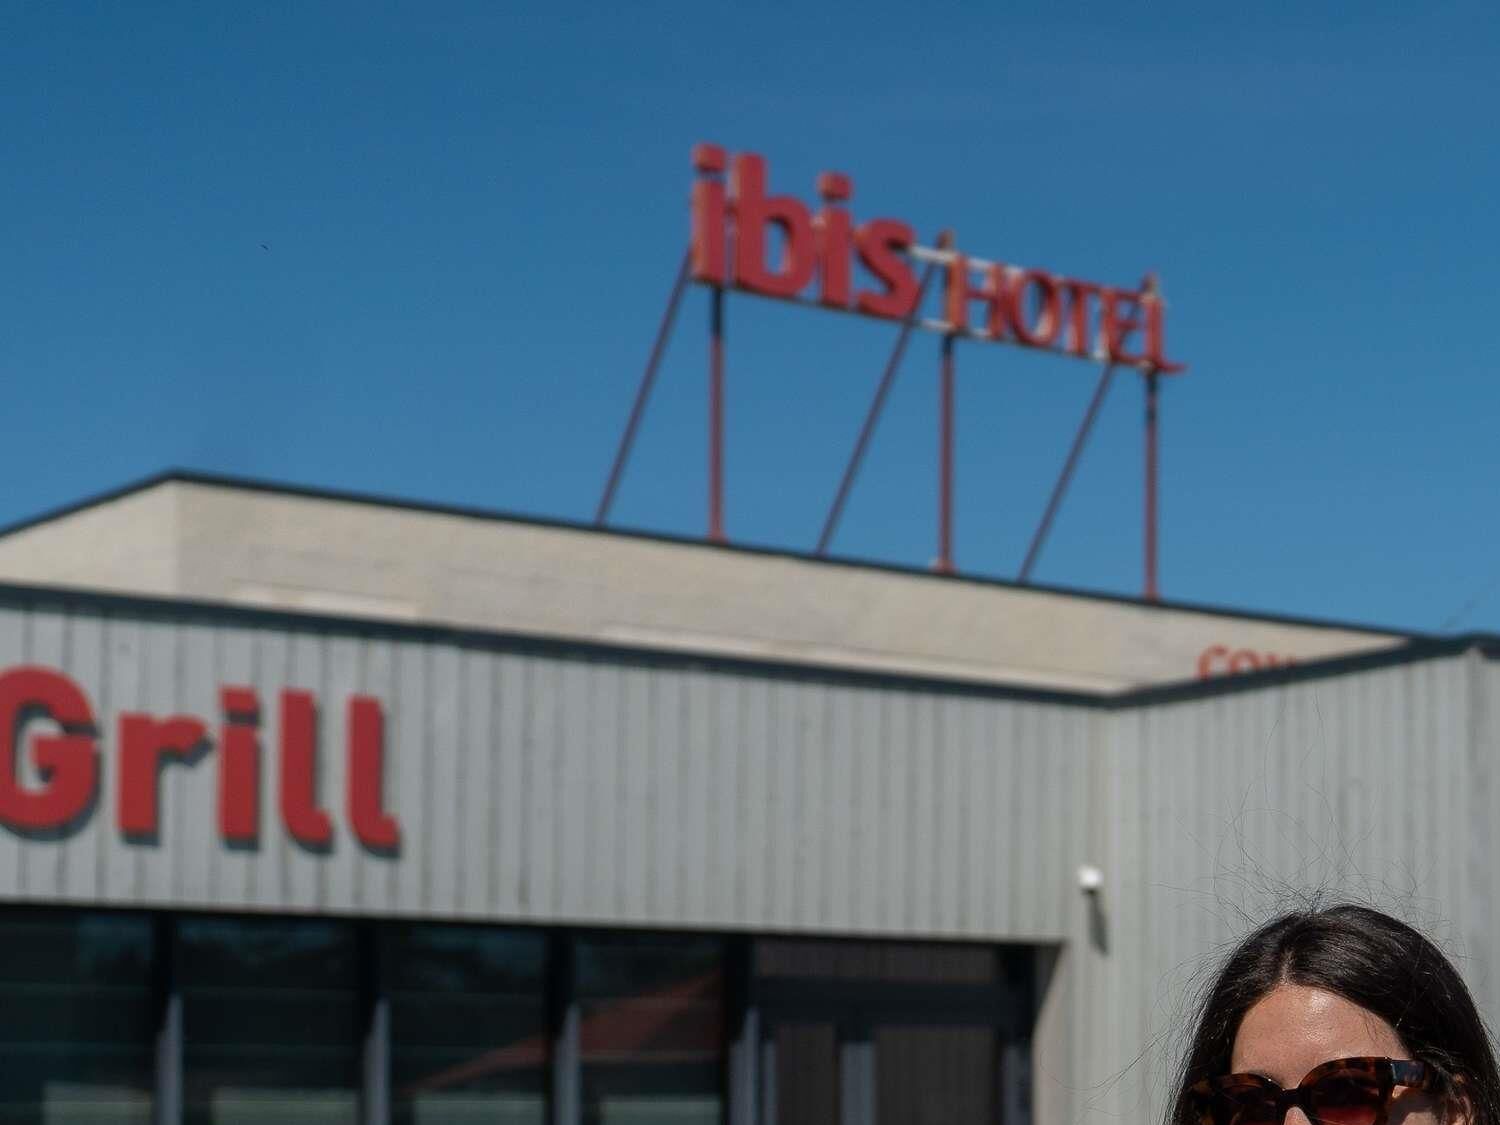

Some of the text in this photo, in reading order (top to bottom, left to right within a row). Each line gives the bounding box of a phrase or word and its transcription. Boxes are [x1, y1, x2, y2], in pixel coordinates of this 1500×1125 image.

[691, 142, 1188, 374] ibis HOTEL
[0, 664, 403, 859] Grill
